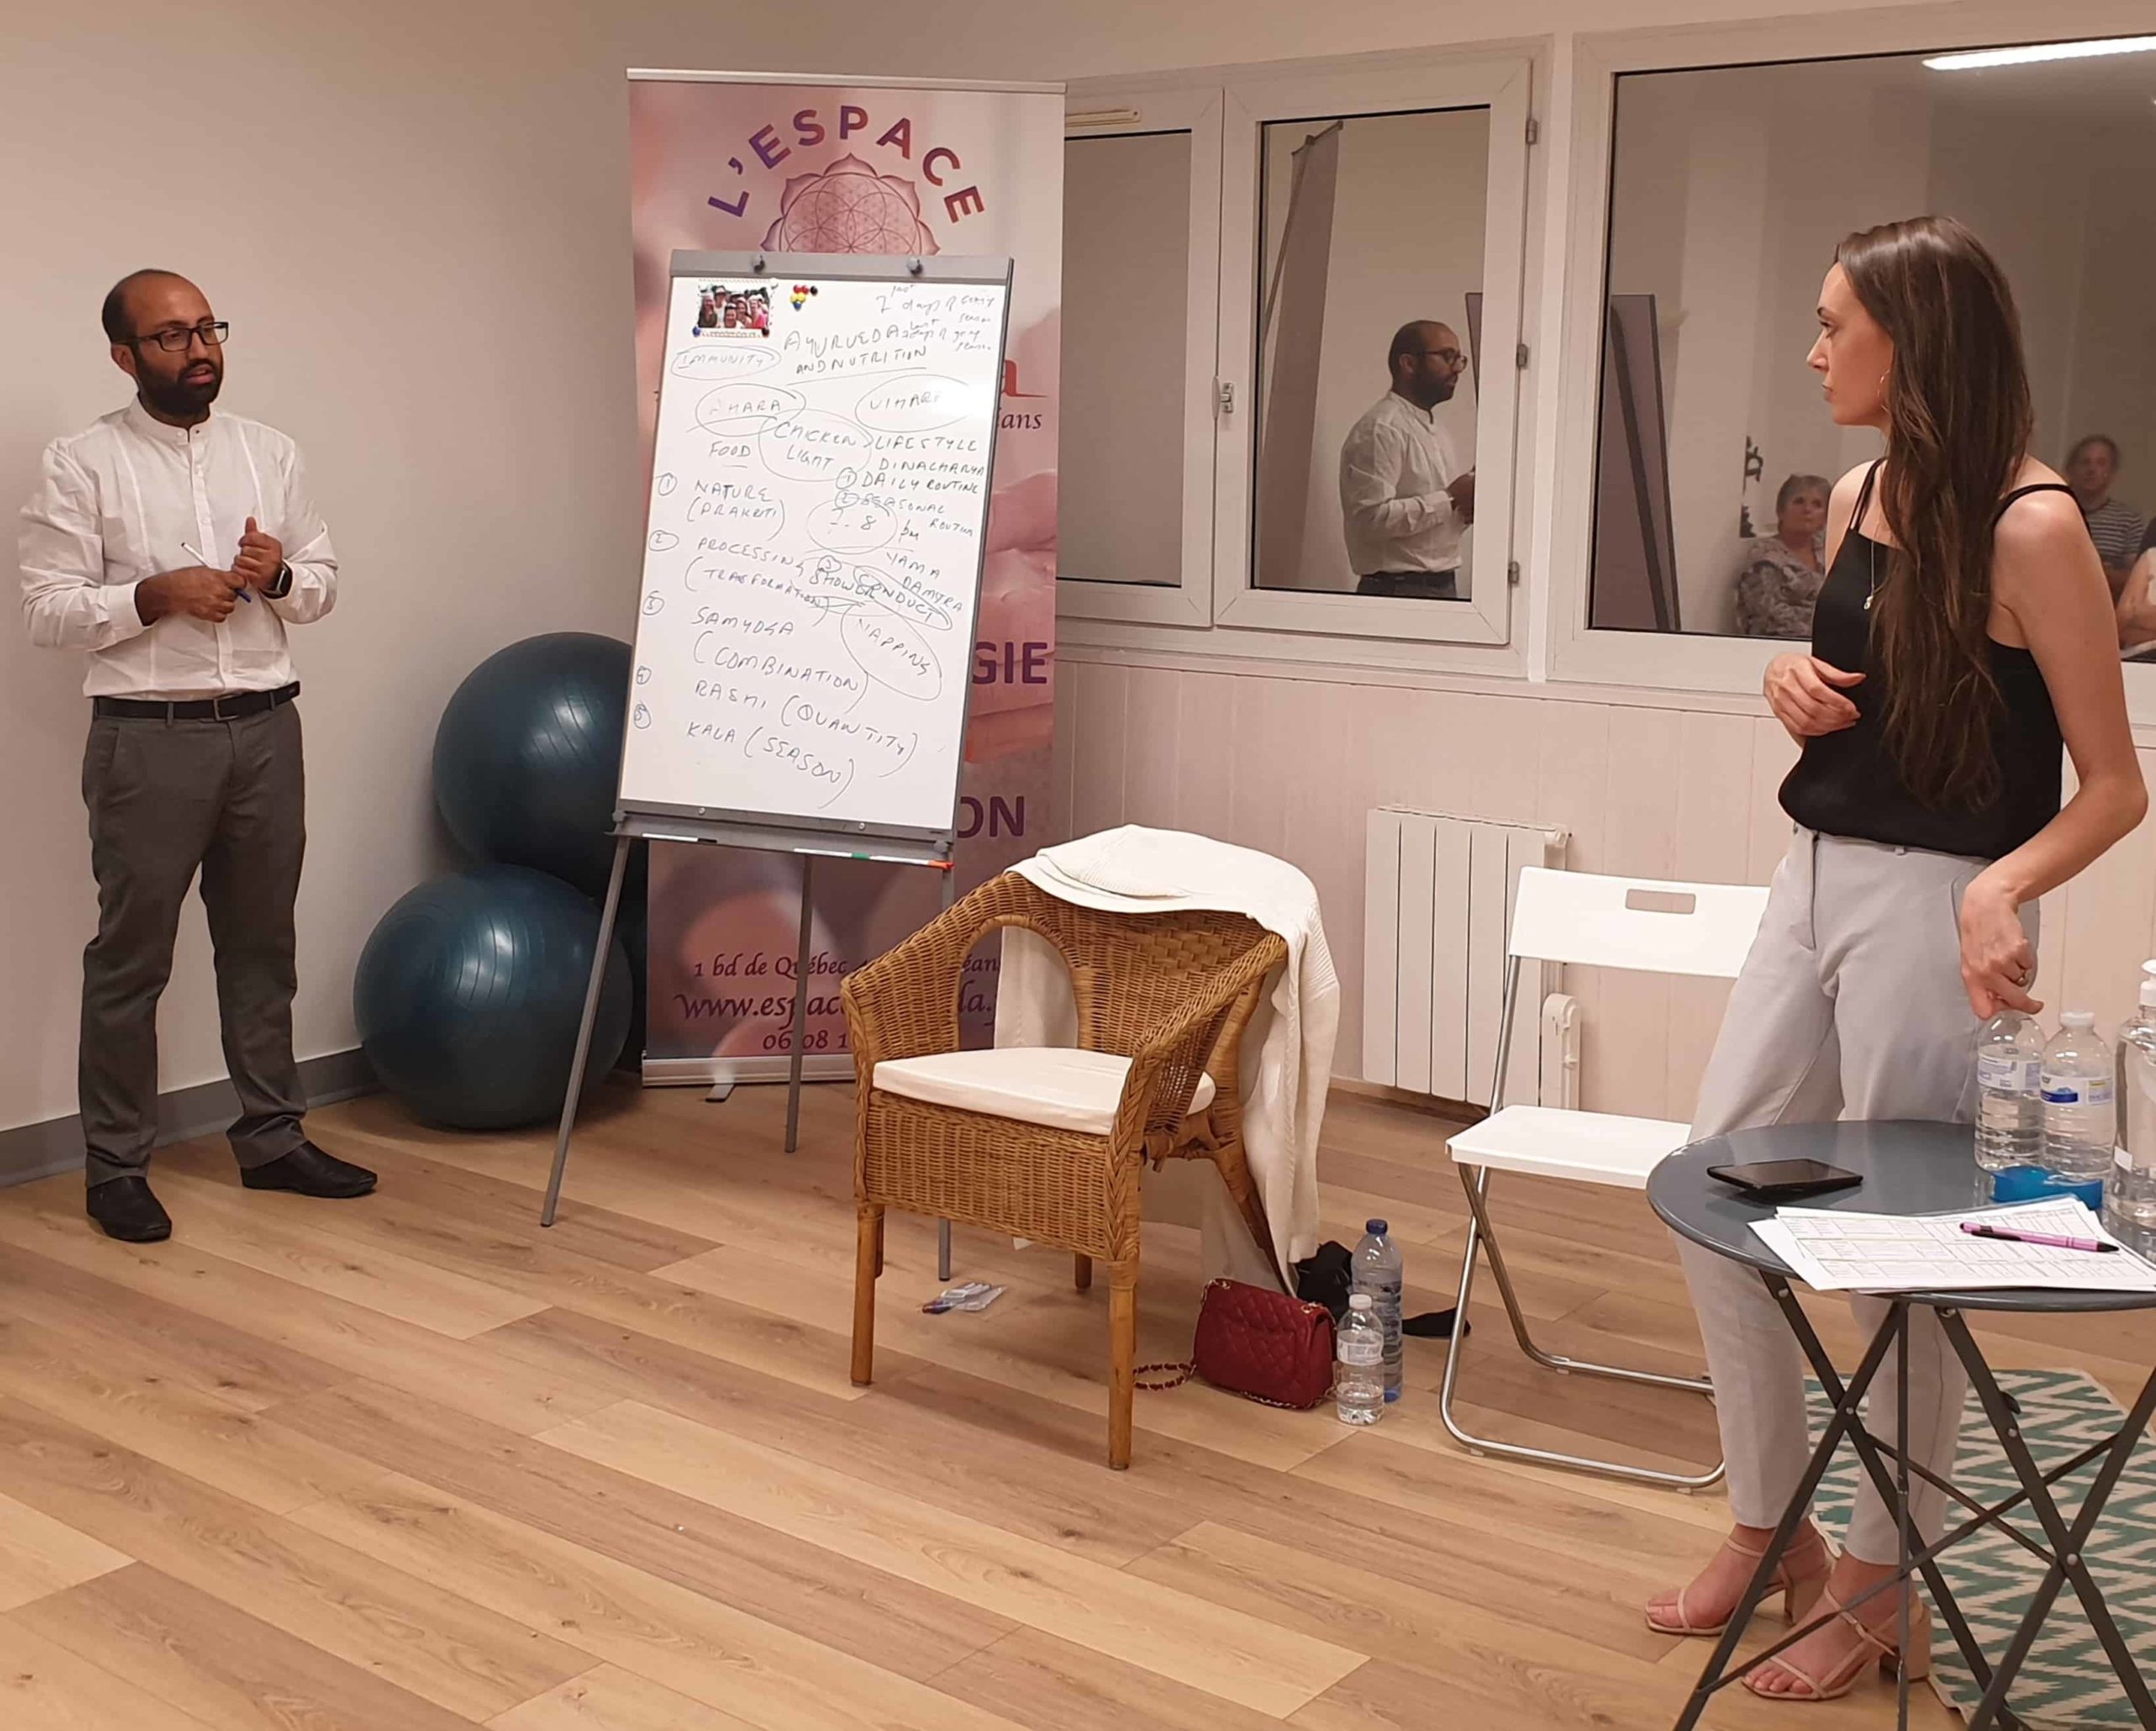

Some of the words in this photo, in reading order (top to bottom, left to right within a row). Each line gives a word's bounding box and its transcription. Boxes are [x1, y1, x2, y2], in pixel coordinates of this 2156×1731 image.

[707, 104, 985, 224] L'ESPACE
[774, 421, 857, 446] CHICKEN
[1001, 414, 1042, 430] ans
[709, 441, 751, 457] FOOD
[876, 435, 978, 451] LIFESTYLE
[695, 479, 772, 503] NATURE
[862, 472, 920, 491] DAILY
[972, 641, 1048, 685] GIE
[686, 721, 735, 744] KALA
[957, 796, 1025, 838] ON
[695, 963, 703, 977] 1
[712, 953, 743, 976] bd
[744, 953, 766, 976] de
[763, 1030, 793, 1050] 06
[802, 1029, 829, 1050] 08
